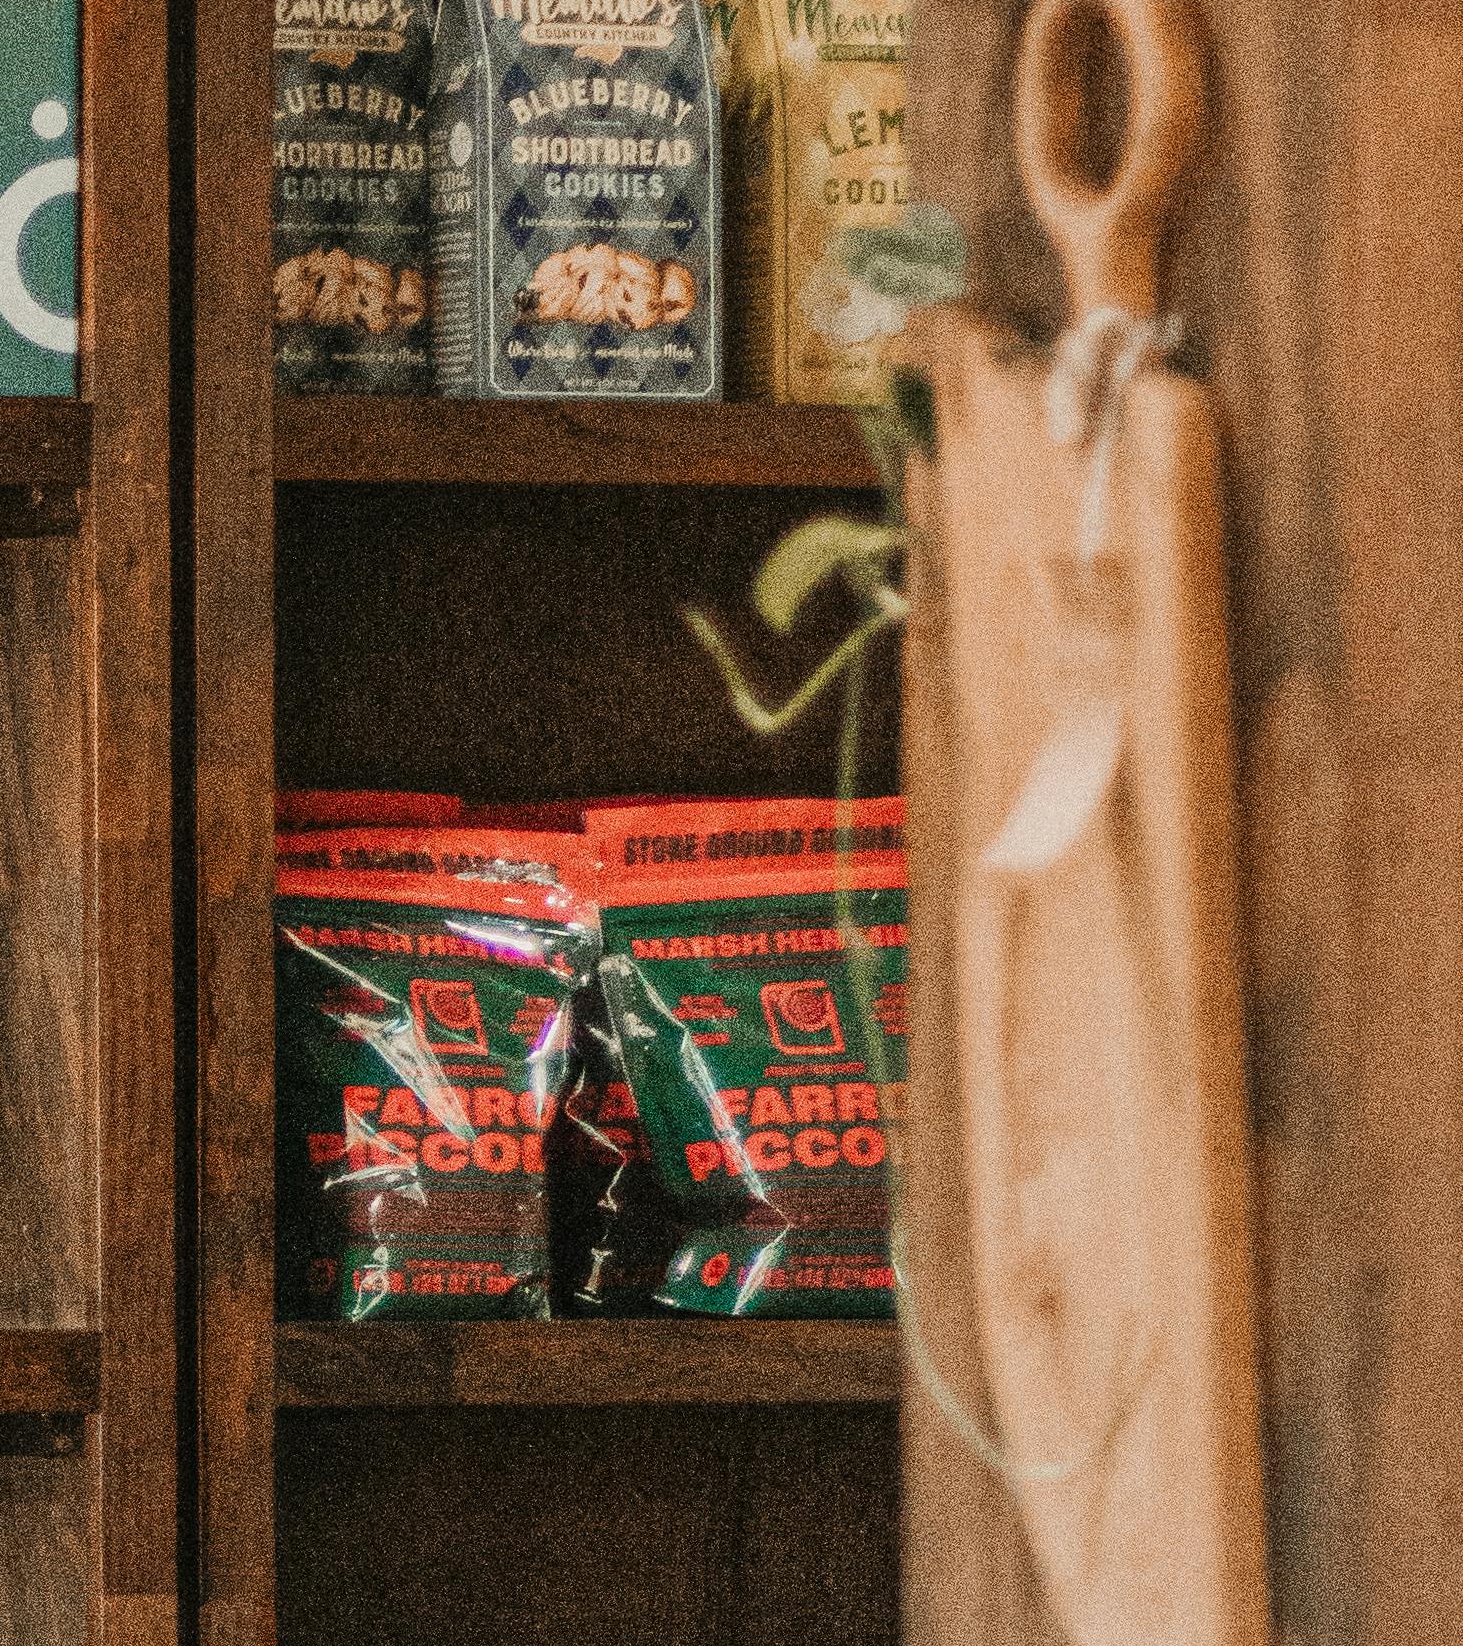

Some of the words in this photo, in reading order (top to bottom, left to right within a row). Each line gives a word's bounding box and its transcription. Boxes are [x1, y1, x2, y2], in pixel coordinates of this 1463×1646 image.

[510, 78, 693, 125] BLUEBERRY
[511, 138, 692, 165] SHORTBREAD
[285, 177, 397, 201] COOKIES
[545, 173, 665, 197] COOKIES
[631, 932, 768, 959] MARSH
